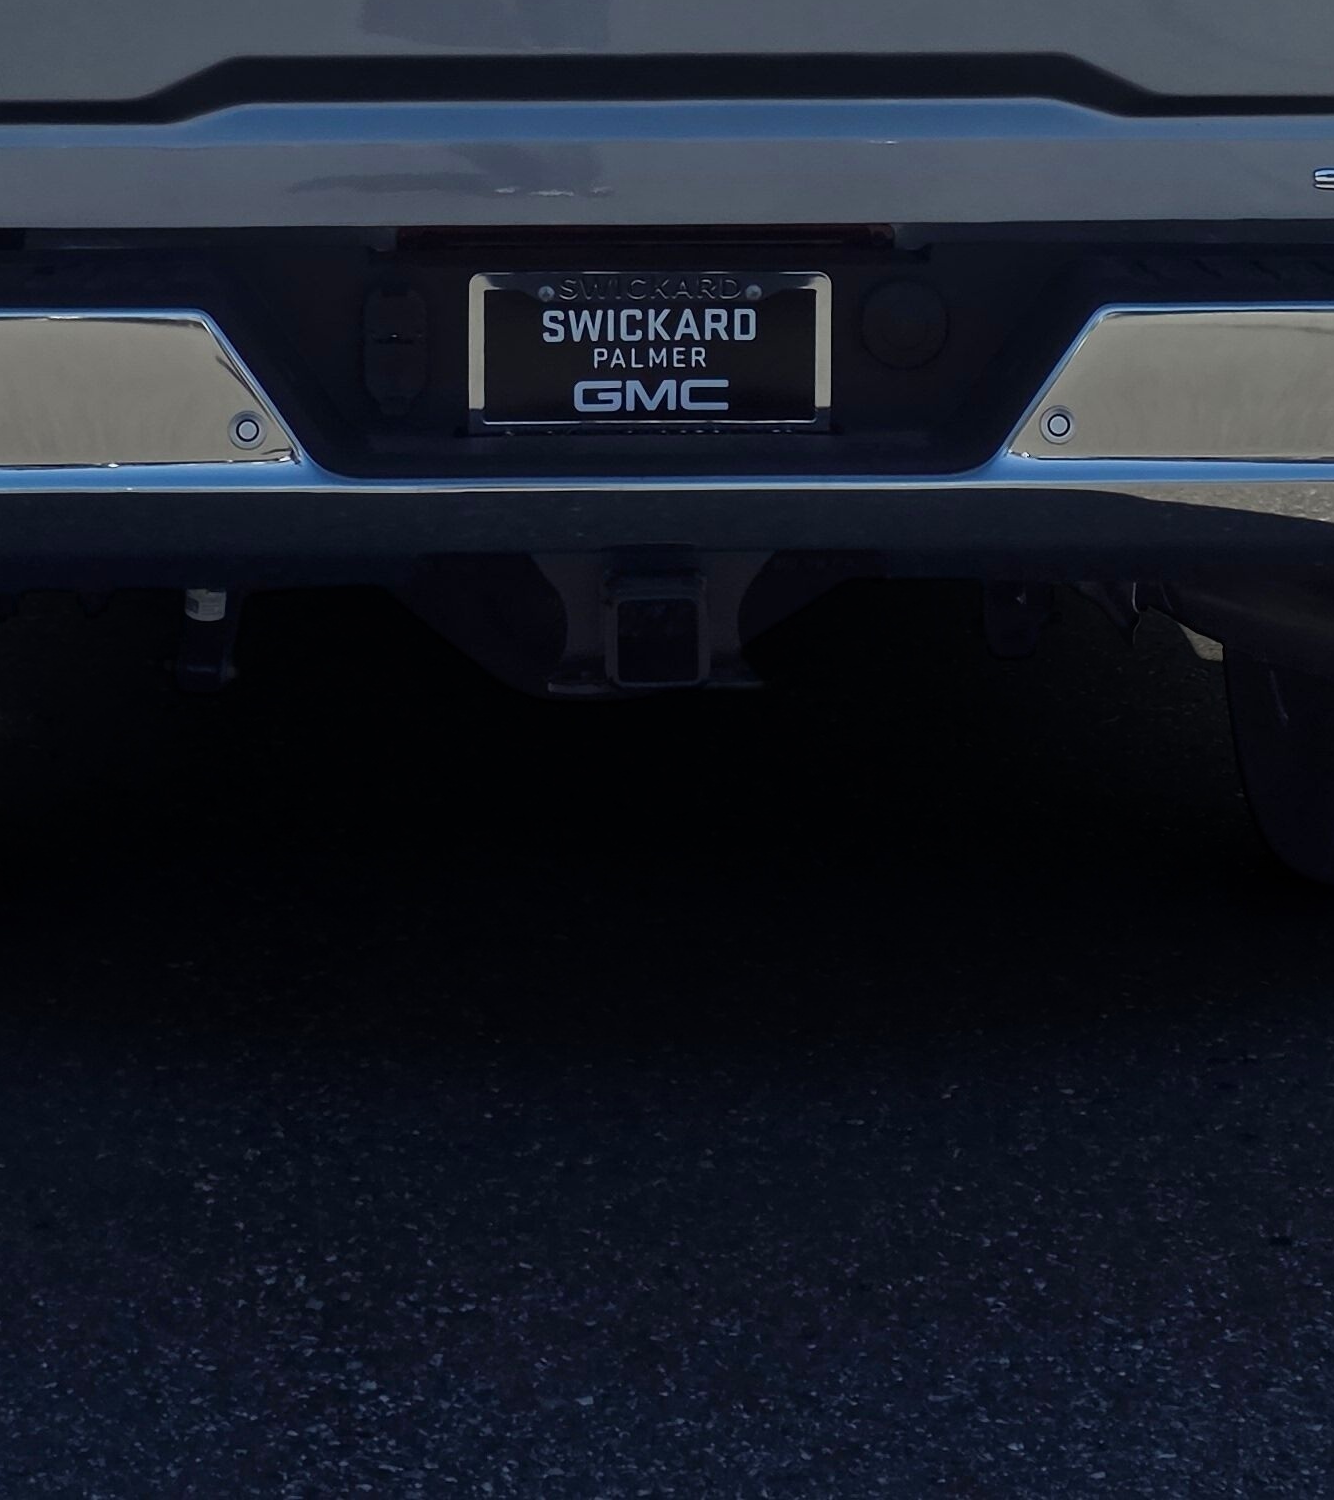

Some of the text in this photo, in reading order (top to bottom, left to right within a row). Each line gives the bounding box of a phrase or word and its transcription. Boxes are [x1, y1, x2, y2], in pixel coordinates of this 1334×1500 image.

[559, 279, 742, 301] SWICKARD
[542, 308, 757, 343] SWICKARD
[593, 347, 707, 369] PALMER
[573, 379, 729, 412] GMC
